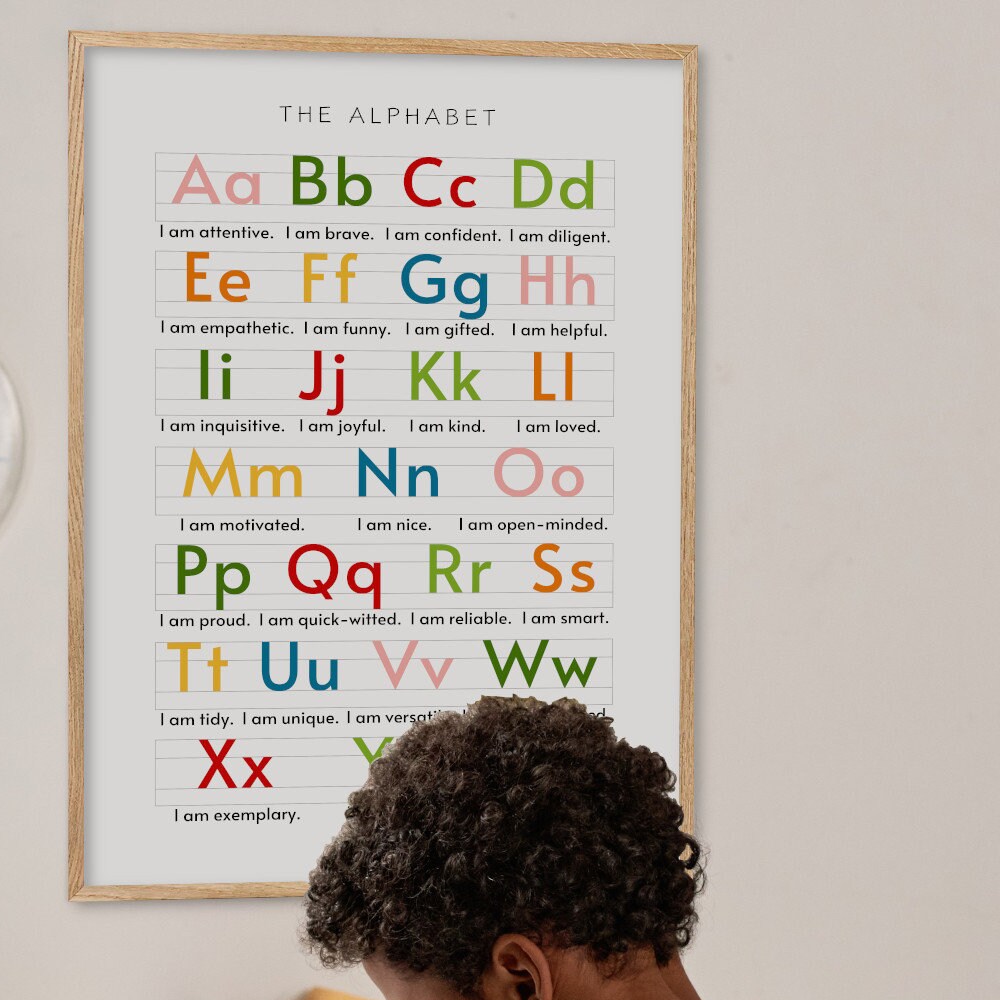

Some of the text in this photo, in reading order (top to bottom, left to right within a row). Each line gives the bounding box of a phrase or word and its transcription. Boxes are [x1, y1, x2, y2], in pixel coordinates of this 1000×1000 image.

[279, 105, 496, 127] THE ALPHABET
[172, 154, 595, 211] Aa Bb Cc Dd
[159, 224, 274, 239] I am attentive.
[285, 225, 375, 241] I am brave.
[385, 227, 502, 242] I am confident.
[509, 228, 611, 247] I am diligent.
[184, 250, 595, 321] Ee Ff Gg Hh
[160, 319, 294, 338] I am empathetic.
[303, 321, 391, 340] I am funny.
[405, 321, 495, 340] I am gifted.
[511, 322, 608, 341] I am helpful.
[199, 348, 574, 417] Ii Jj Kk Ll
[160, 418, 285, 436] I am inquisitive.
[298, 418, 386, 437] I am joyful.
[409, 419, 486, 433] I am kind.
[516, 419, 601, 433] I am loved.
[181, 447, 585, 498] Mm Nn Oo
[179, 517, 305, 532] I am motivated.
[356, 517, 432, 531] I am nice.
[458, 517, 608, 535] I am open-minded.
[176, 542, 596, 612] Pp Qq Rr Ss
[159, 612, 251, 631] I am proud.
[258, 611, 401, 630] I am quick-witted.
[410, 611, 512, 625] I am reliable.
[521, 611, 609, 625] I am smart.
[166, 639, 597, 694] Tt Uu Vv Ww
[159, 712, 234, 730] I am tidy.
[241, 711, 339, 729] I am unique.
[346, 710, 351, 724] I
[355, 714, 381, 724] am
[196, 737, 274, 790] Xx
[173, 807, 301, 825] I am exemplary.
